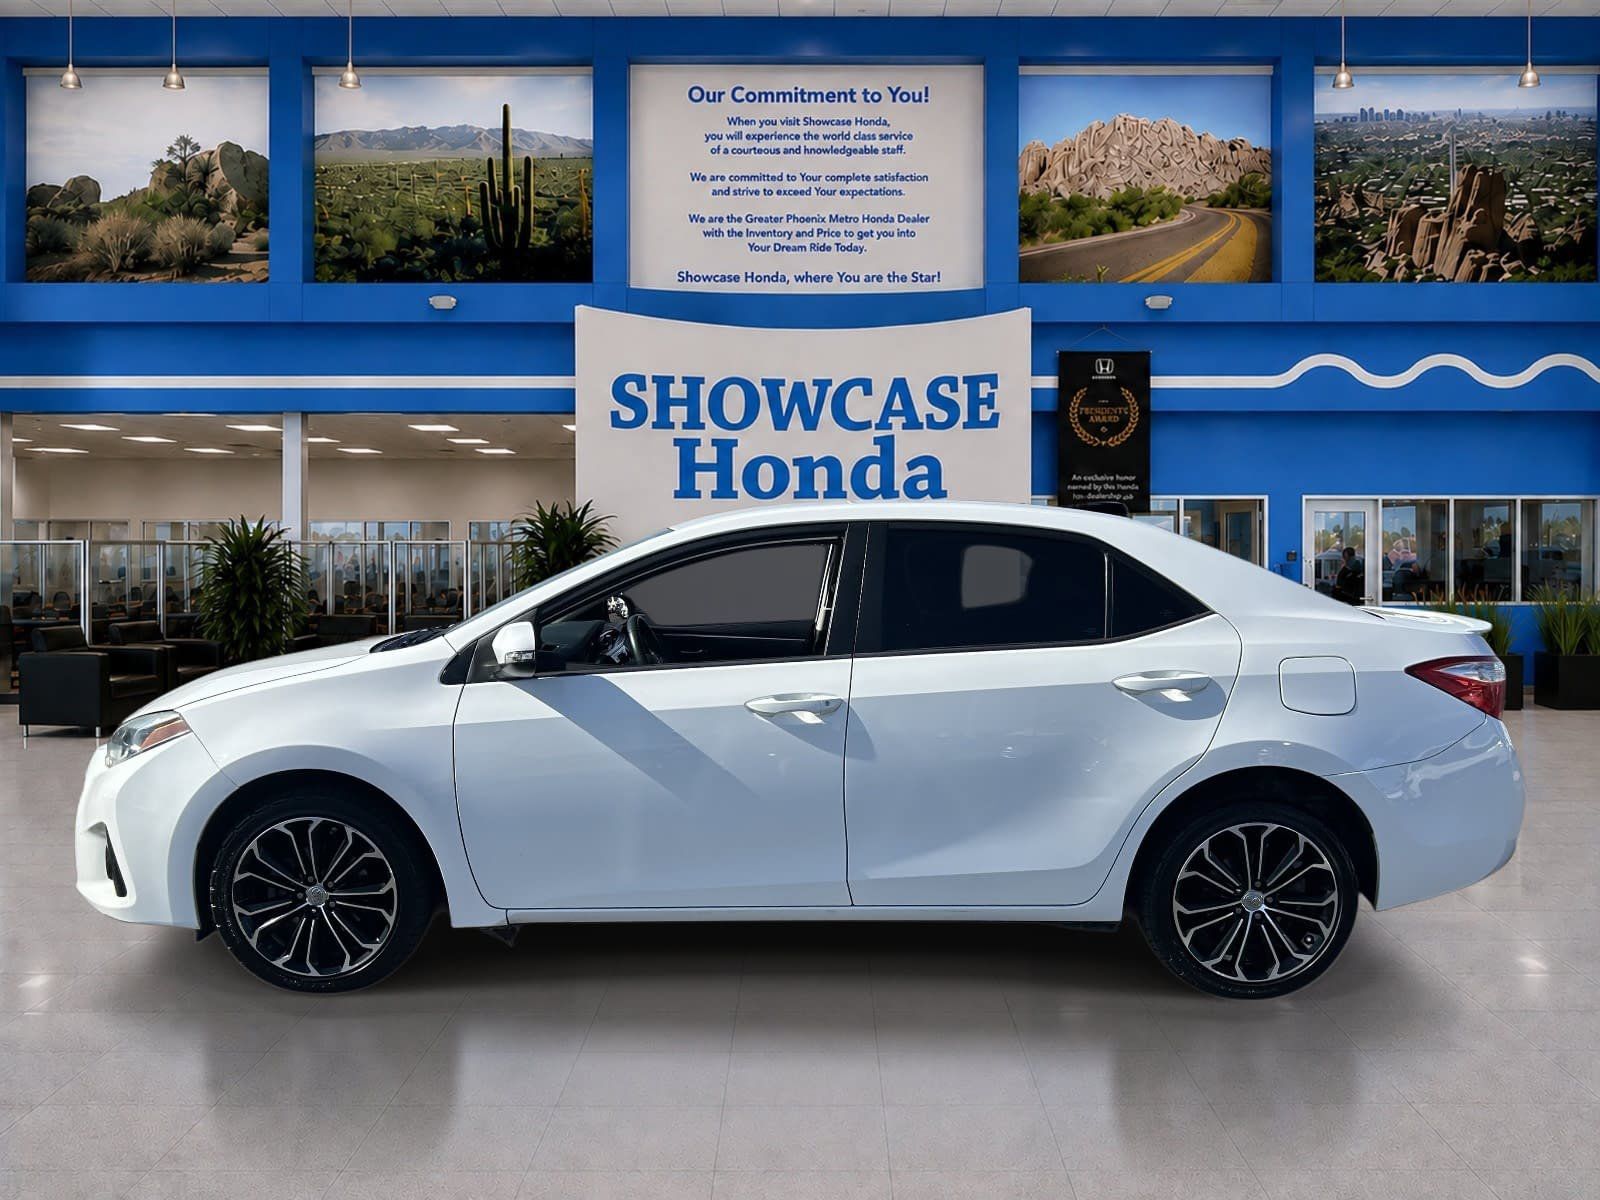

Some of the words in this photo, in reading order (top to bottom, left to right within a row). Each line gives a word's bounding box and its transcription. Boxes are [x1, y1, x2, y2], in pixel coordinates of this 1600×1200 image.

[688, 86, 726, 103] Our
[731, 86, 857, 104] Commitment
[861, 88, 883, 103] to
[886, 86, 929, 103] You!
[726, 116, 756, 126] When
[758, 119, 778, 129] you
[779, 116, 801, 127] visit
[803, 116, 852, 127] Showcase
[854, 116, 891, 128] Honda,
[704, 133, 723, 143] you
[725, 130, 743, 141] will
[745, 131, 801, 143] experience
[803, 130, 820, 141] the
[822, 131, 851, 141] world
[853, 131, 877, 141] class
[878, 131, 913, 141] service
[710, 144, 721, 155] of
[722, 147, 729, 155] a
[731, 146, 781, 155] courteous
[782, 145, 801, 155] and
[881, 144, 906, 155] staff.
[690, 172, 707, 182] We
[728, 172, 784, 182] committed
[786, 173, 797, 182] to
[799, 172, 822, 182] Your
[824, 172, 871, 185] complete
[873, 172, 929, 182] satisfaction
[711, 186, 731, 196] and
[732, 186, 761, 196] strive
[763, 188, 774, 196] to
[776, 186, 812, 196] exceed
[814, 186, 837, 196] Your
[839, 186, 905, 199] expectations.
[688, 214, 706, 224] We
[707, 216, 724, 224] are
[726, 213, 743, 224] the
[745, 213, 784, 224] Greater
[786, 213, 826, 224] Phoenix
[829, 214, 860, 224] Metro
[862, 213, 895, 224] Honda
[897, 213, 930, 224] Dealer
[702, 228, 725, 238] with
[727, 228, 744, 238] the
[745, 228, 793, 241] Inventory
[795, 228, 814, 238] and
[816, 228, 842, 238] Price
[844, 229, 855, 238] to
[856, 229, 874, 241] get
[876, 230, 895, 241] you
[897, 228, 916, 238] into
[747, 242, 771, 252] Your
[773, 242, 807, 252] Dream
[809, 242, 832, 252] Ride
[834, 242, 867, 255] Today.
[677, 270, 741, 283] Showcase
[744, 271, 790, 285] Honda,
[793, 271, 834, 283] where
[836, 271, 860, 283] You
[863, 274, 884, 283] are
[886, 271, 908, 283] the
[911, 271, 941, 283] Star!
[610, 373, 1000, 431] SHOWCASE
[673, 434, 948, 499] Honda
[1093, 483, 1102, 492] by
